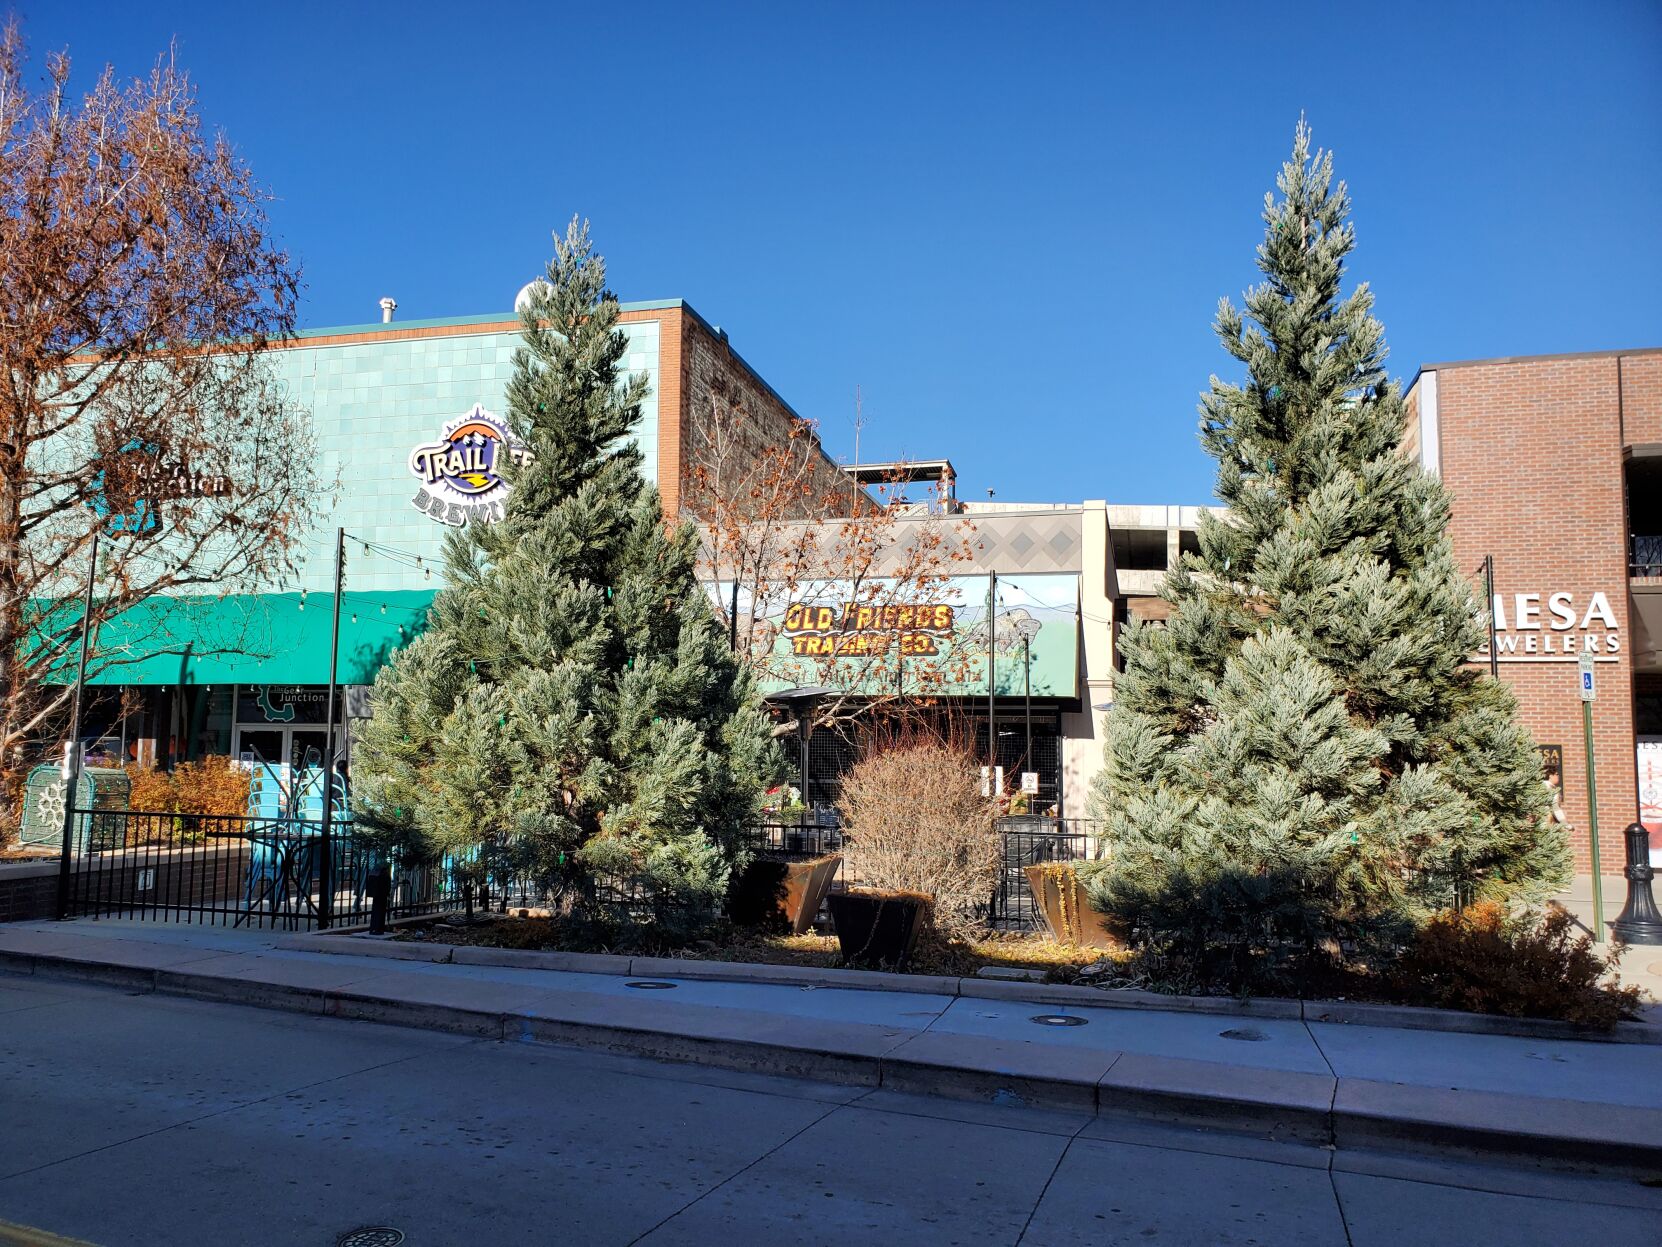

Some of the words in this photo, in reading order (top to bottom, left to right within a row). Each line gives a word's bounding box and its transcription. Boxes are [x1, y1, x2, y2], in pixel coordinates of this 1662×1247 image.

[412, 442, 488, 482] TRAIL
[488, 441, 536, 476] LFE
[412, 487, 508, 524] BREWI
[785, 602, 833, 631] OLD
[1477, 634, 1621, 654] EWELERS
[280, 693, 325, 702] Junction
[1537, 749, 1559, 759] ESA
